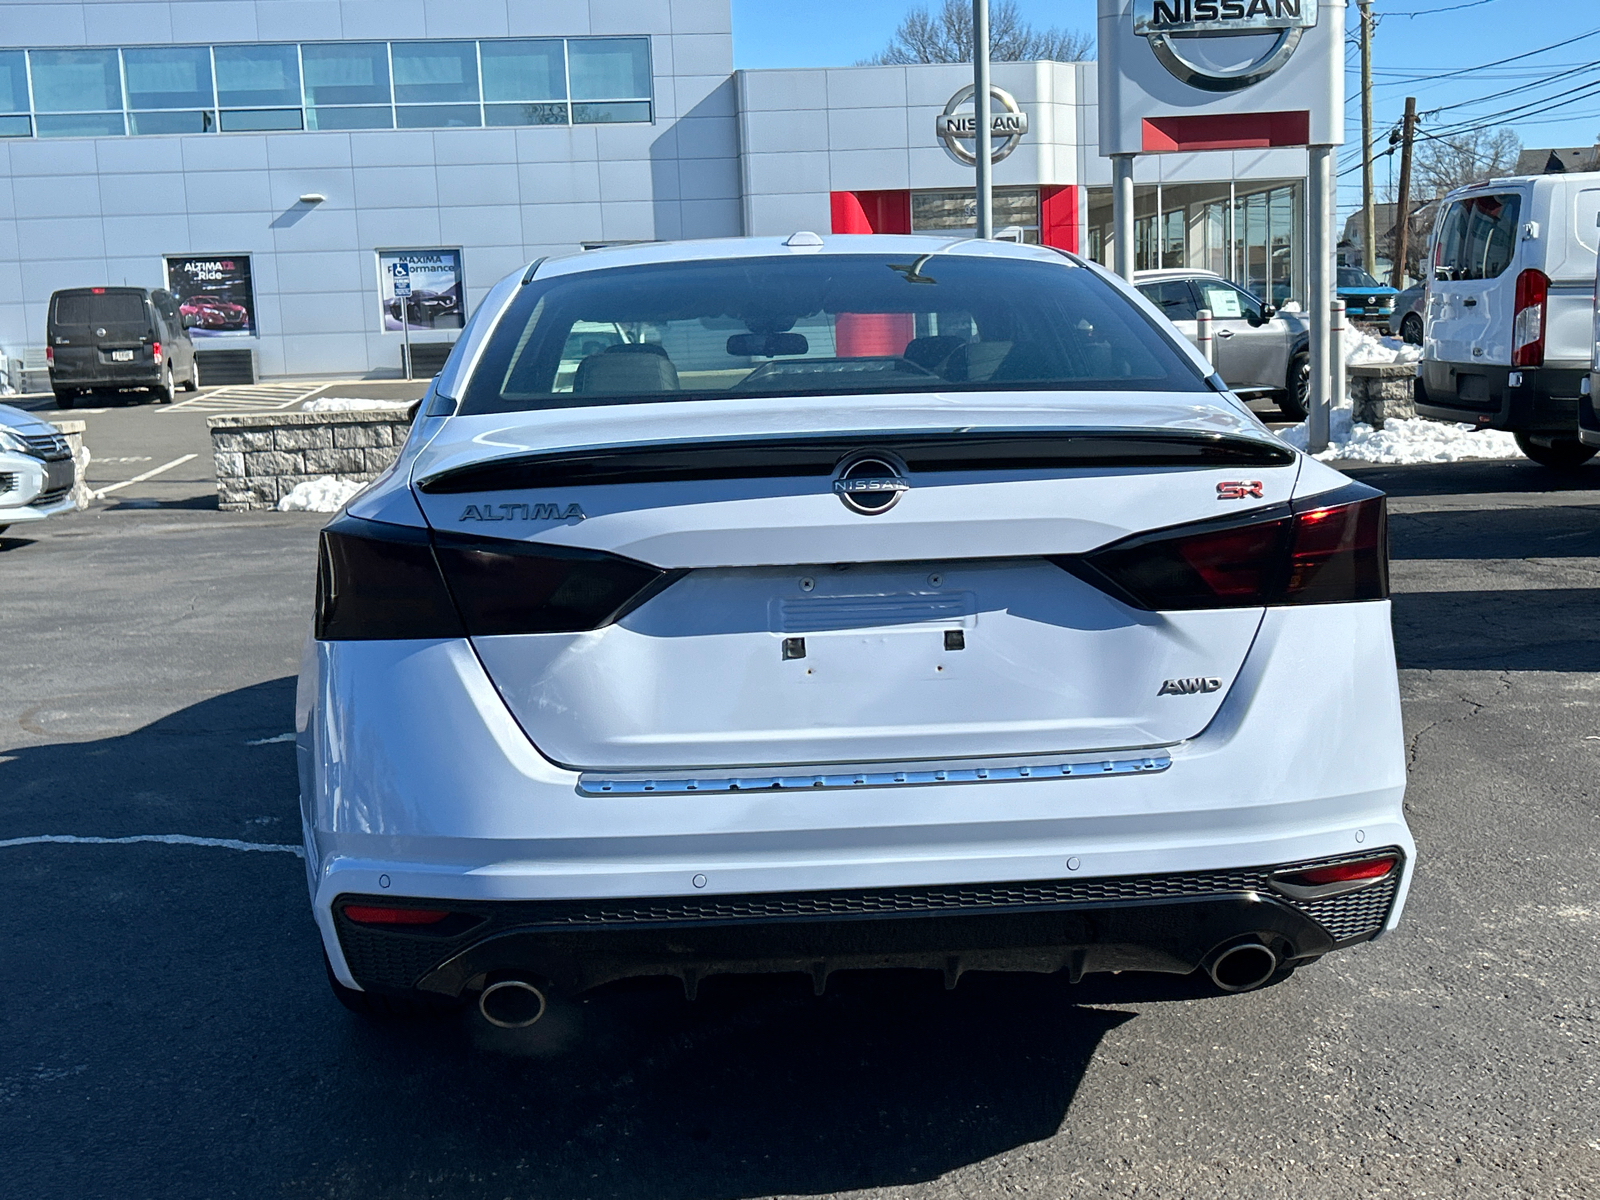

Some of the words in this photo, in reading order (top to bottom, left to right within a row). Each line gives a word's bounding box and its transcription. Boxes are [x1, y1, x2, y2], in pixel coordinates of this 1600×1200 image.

[1153, 0, 1301, 25] NISSAN
[946, 117, 1020, 131] NISAN
[399, 256, 443, 264] MAXIMA
[198, 271, 222, 280] Ride
[387, 265, 455, 273] Pormance
[834, 480, 908, 490] NISSAN
[1216, 480, 1264, 500] SR
[459, 503, 586, 521] ALTIMA
[1157, 677, 1222, 696] AWD
